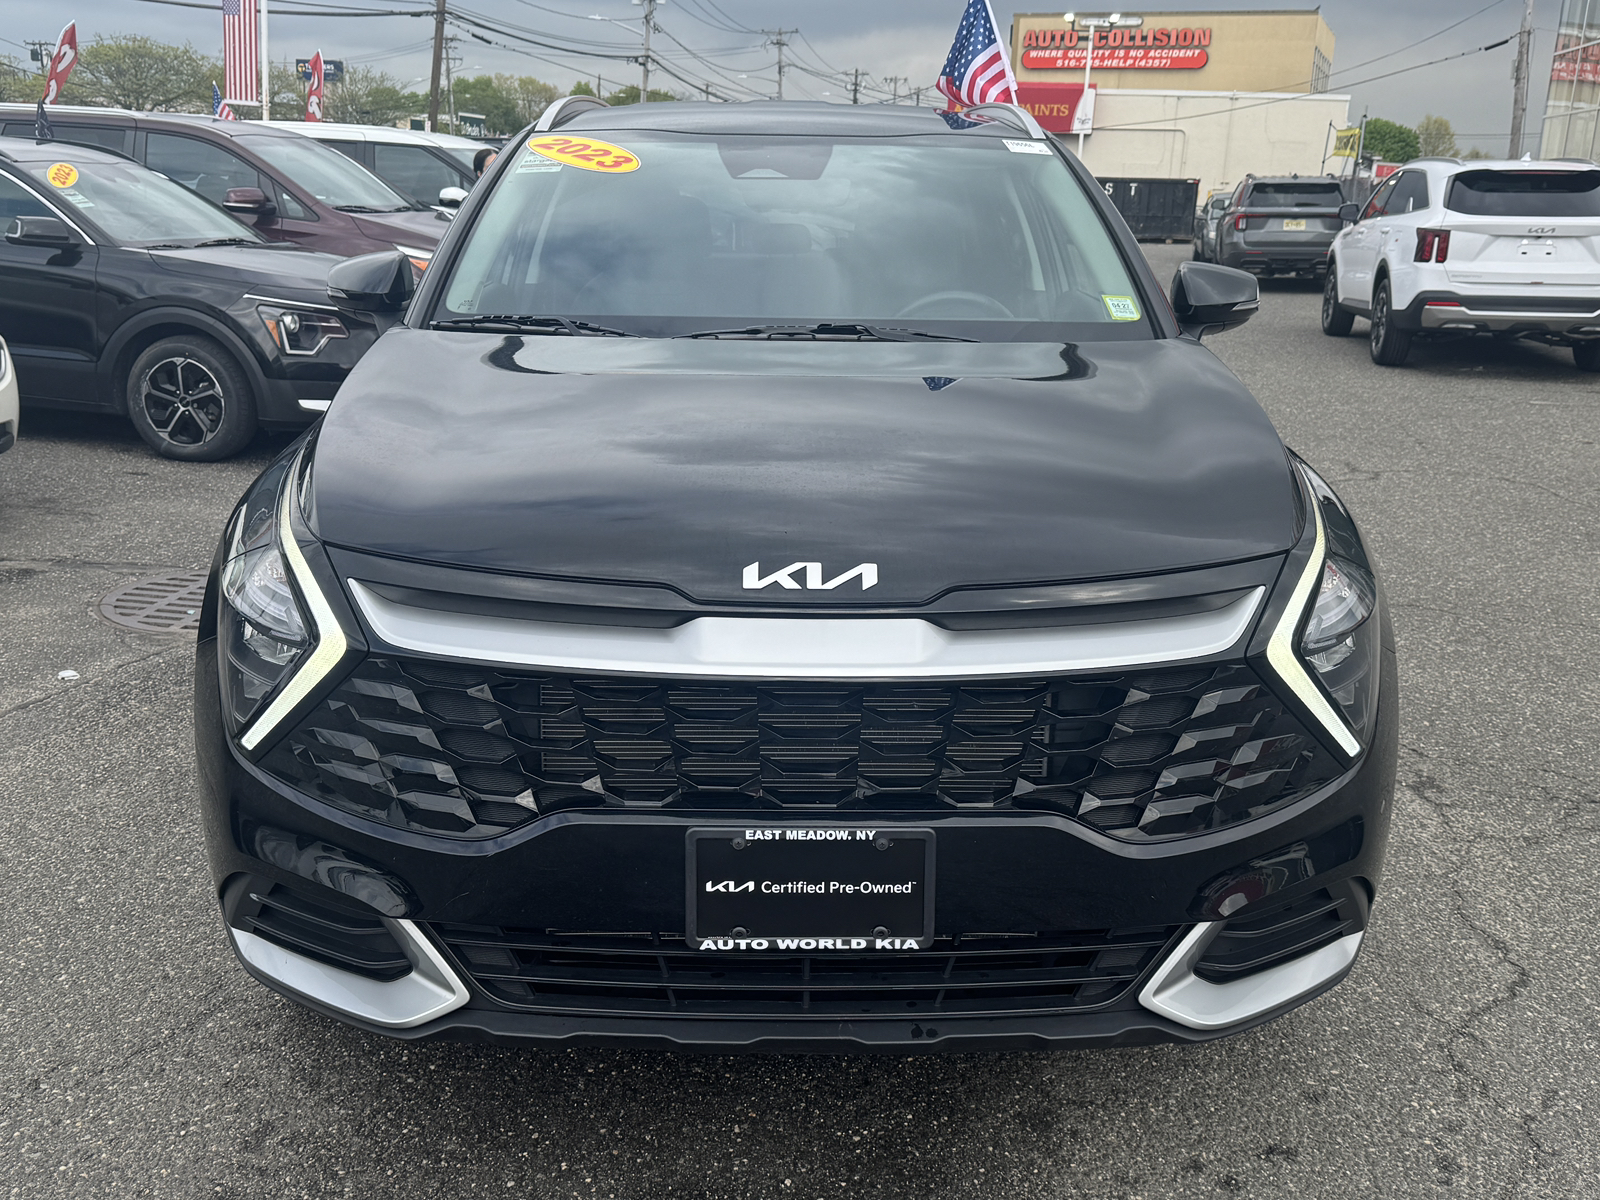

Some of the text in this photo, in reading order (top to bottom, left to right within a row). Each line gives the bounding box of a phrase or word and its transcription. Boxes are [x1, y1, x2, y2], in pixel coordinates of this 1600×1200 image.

[1023, 28, 1212, 47] AUTO COLLISION
[1029, 50, 1063, 58] WHERE
[1114, 49, 1125, 58] IS
[1129, 49, 1145, 58] NO
[1148, 49, 1200, 58] ACCIDENT
[1134, 58, 1171, 68] (4357)
[532, 138, 634, 169] 2023
[51, 163, 74, 186] 2023
[742, 561, 878, 591] KIA
[745, 830, 782, 840] EAST
[856, 830, 877, 840] NY
[705, 880, 755, 893] KIA
[760, 881, 825, 893] Certified
[699, 939, 920, 950] AUTO WORLD KIA
